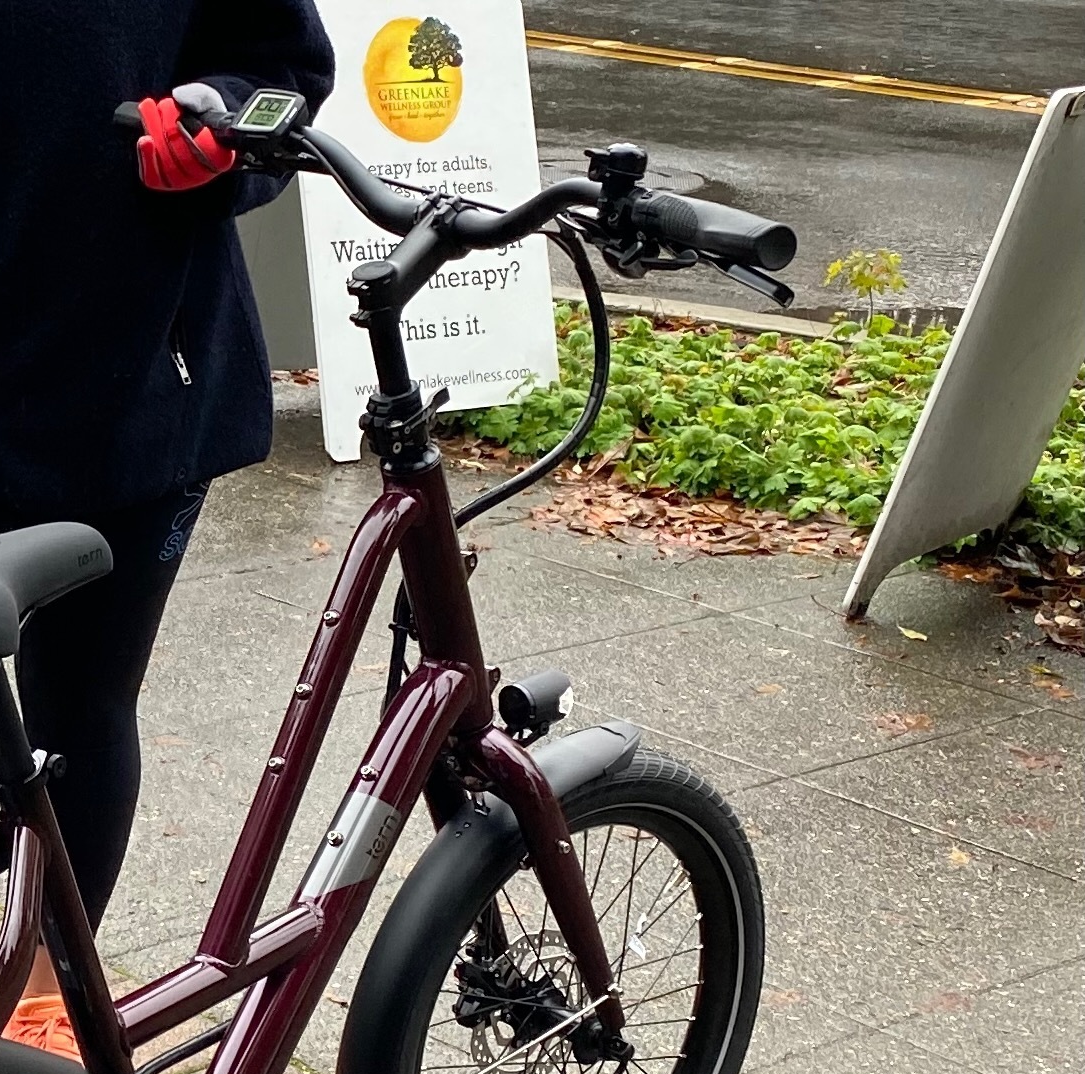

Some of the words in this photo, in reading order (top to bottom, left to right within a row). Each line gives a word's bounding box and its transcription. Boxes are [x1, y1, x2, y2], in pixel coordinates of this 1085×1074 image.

[377, 86, 450, 101] GREENLAKE
[379, 101, 421, 111] WELLNESS
[422, 100, 452, 110] GROUP
[367, 161, 413, 179] erapy
[416, 157, 438, 174] for
[442, 154, 492, 173] adults,
[452, 180, 499, 195] teens.
[443, 316, 460, 338] is
[466, 313, 487, 336] it.
[77, 547, 104, 567] tern
